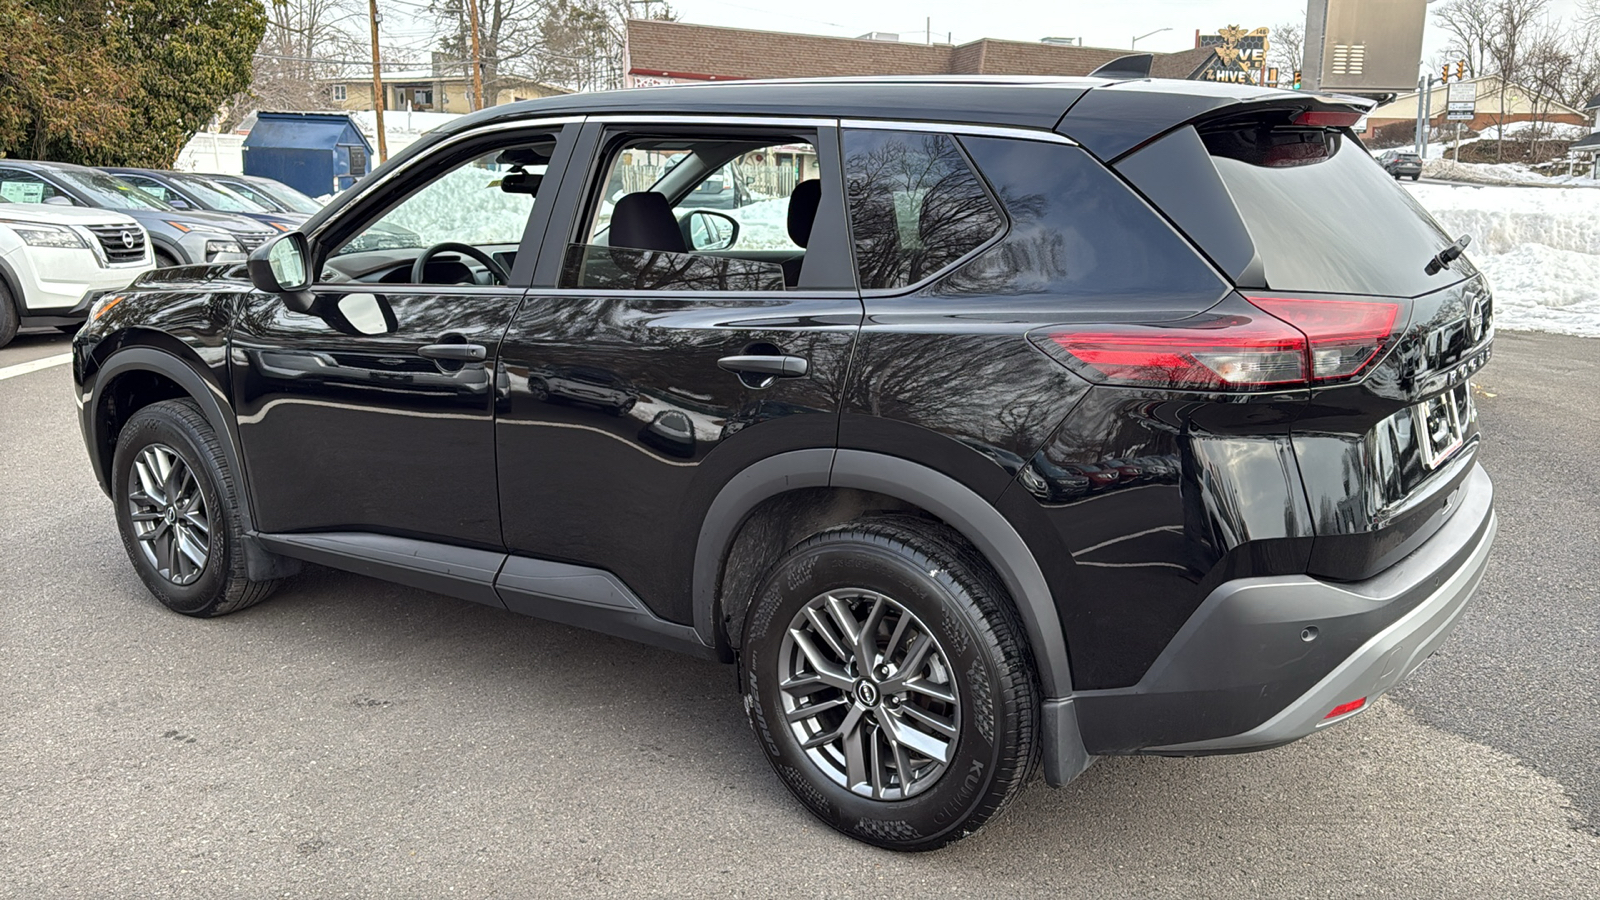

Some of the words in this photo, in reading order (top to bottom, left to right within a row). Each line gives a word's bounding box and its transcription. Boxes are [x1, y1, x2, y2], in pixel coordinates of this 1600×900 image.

[1216, 69, 1246, 83] HIVE
[749, 671, 780, 757] CRUGEN
[934, 759, 984, 825] KUMHO
